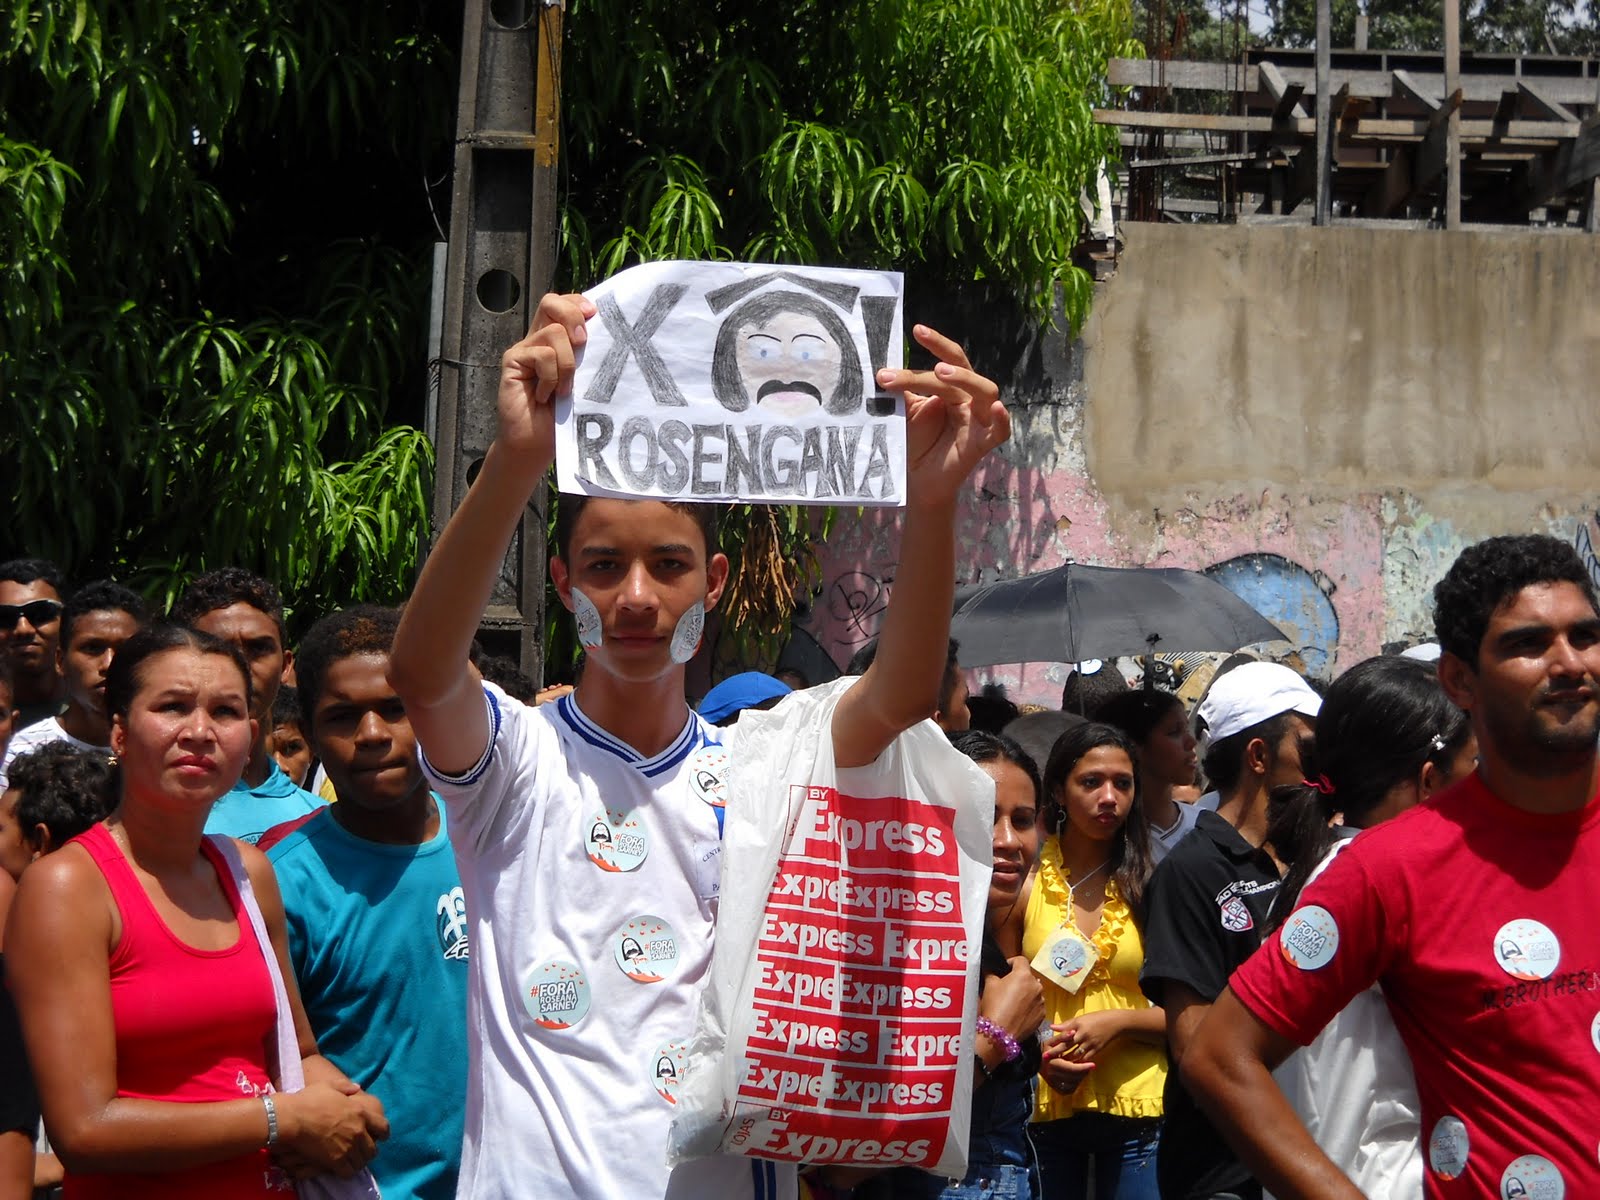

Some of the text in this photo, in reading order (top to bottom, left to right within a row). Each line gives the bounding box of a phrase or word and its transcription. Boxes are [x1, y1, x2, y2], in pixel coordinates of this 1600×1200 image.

[576, 413, 895, 498] ROSENGANA
[809, 788, 828, 800] BY
[803, 799, 945, 866] Express
[840, 875, 954, 918] Express
[758, 912, 874, 957] Express
[1294, 919, 1326, 948] #FORA
[530, 981, 576, 998] #FORA
[539, 994, 577, 1004] ROSEANA
[540, 1001, 576, 1012] SARNEY
[838, 973, 952, 1016] Express
[752, 1008, 869, 1055] Express
[828, 1071, 943, 1113] Express
[771, 1109, 792, 1121] BY
[761, 1121, 931, 1163] Express
